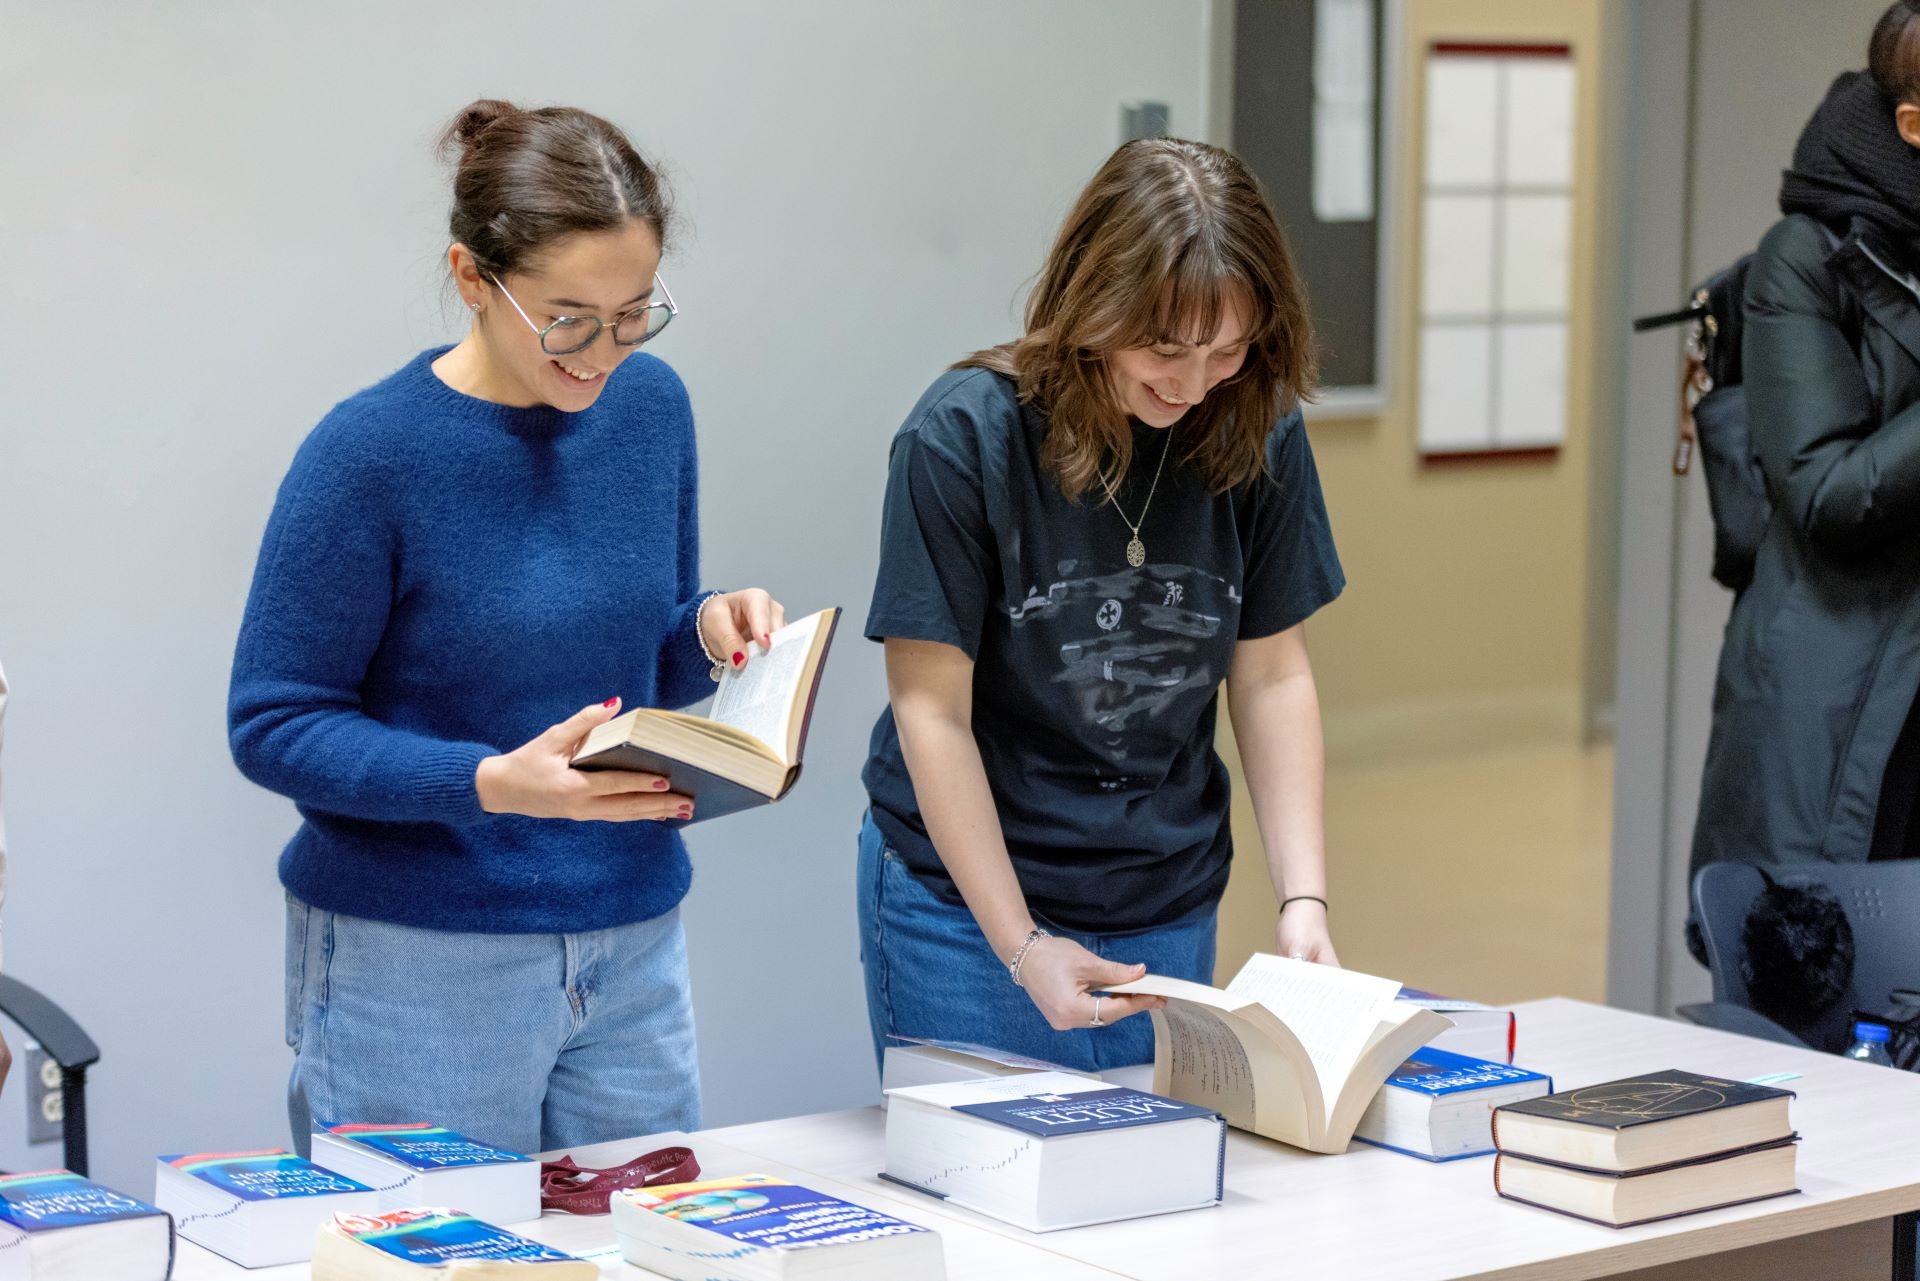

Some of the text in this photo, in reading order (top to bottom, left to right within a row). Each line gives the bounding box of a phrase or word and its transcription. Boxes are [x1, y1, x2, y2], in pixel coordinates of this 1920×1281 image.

[1397, 1063, 1505, 1084] MICRO
[1027, 1100, 1184, 1125] MULTI
[431, 1154, 518, 1164] Oxford
[261, 1182, 356, 1197] Oxford
[24, 1197, 137, 1220] Oxford
[733, 1212, 881, 1240] Contemporary
[792, 1216, 897, 1238] Dictionary
